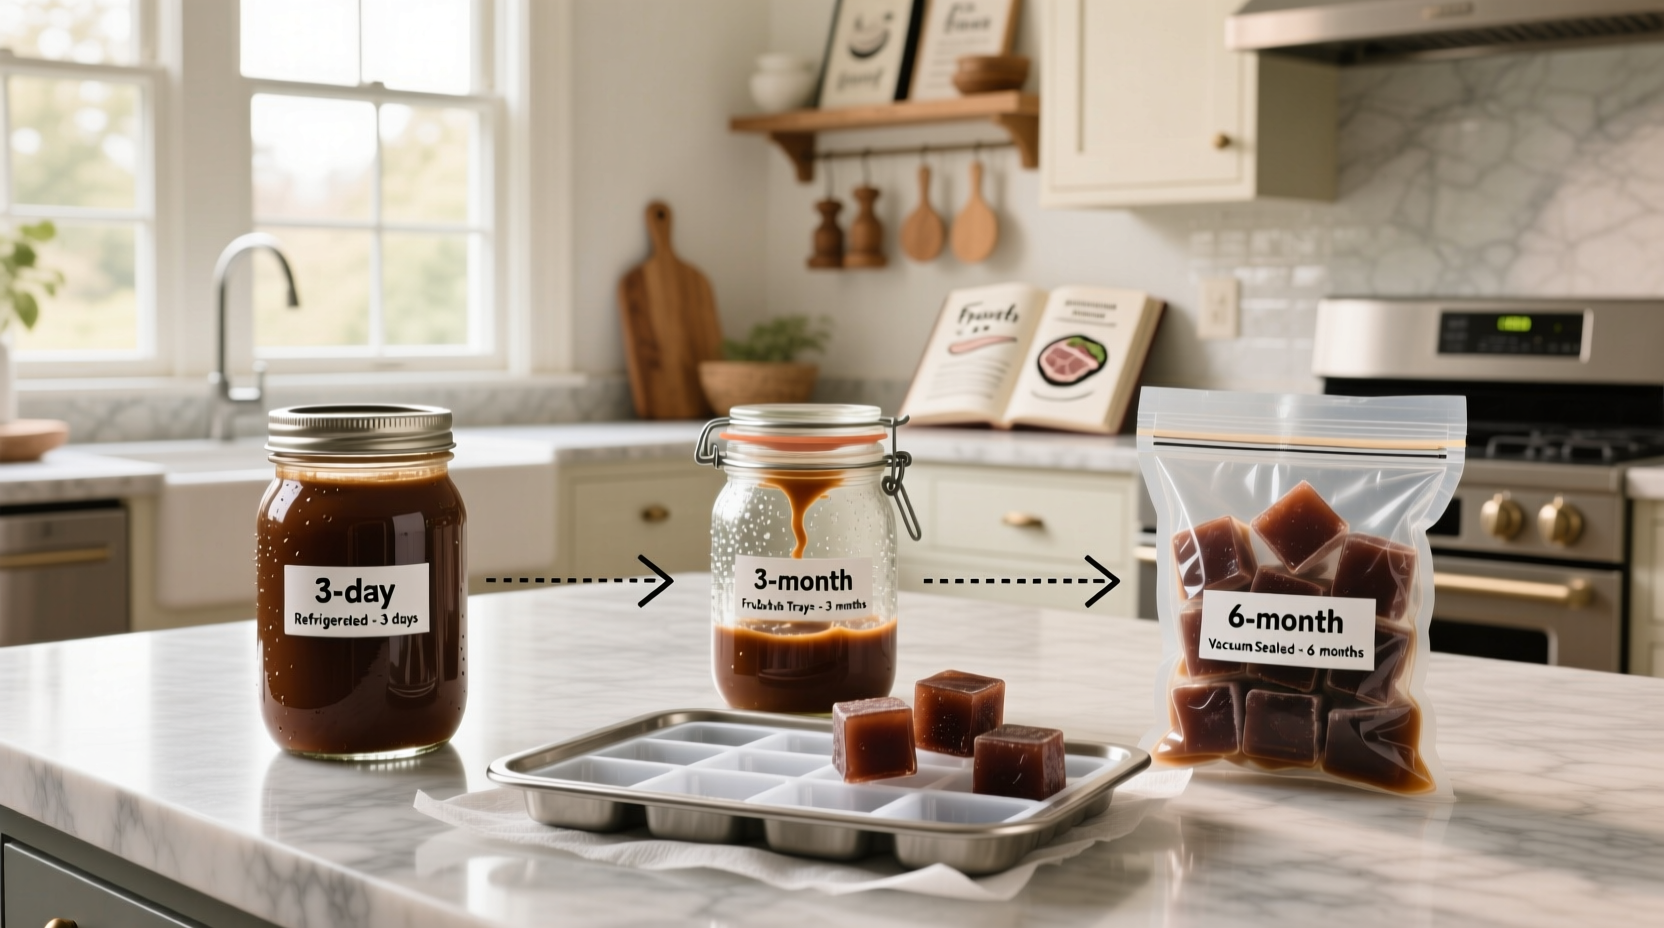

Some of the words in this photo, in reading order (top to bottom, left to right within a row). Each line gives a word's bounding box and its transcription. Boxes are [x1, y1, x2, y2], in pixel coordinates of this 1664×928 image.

[754, 568, 853, 591] 3-month
[315, 577, 395, 609] 3-day
[825, 601, 832, 611] 3
[380, 613, 388, 625] 3
[391, 612, 418, 628] days
[1228, 604, 1344, 634] 6-month
[1255, 641, 1295, 655] Sealed
[1307, 644, 1315, 656] 6
[1319, 645, 1364, 658] months
